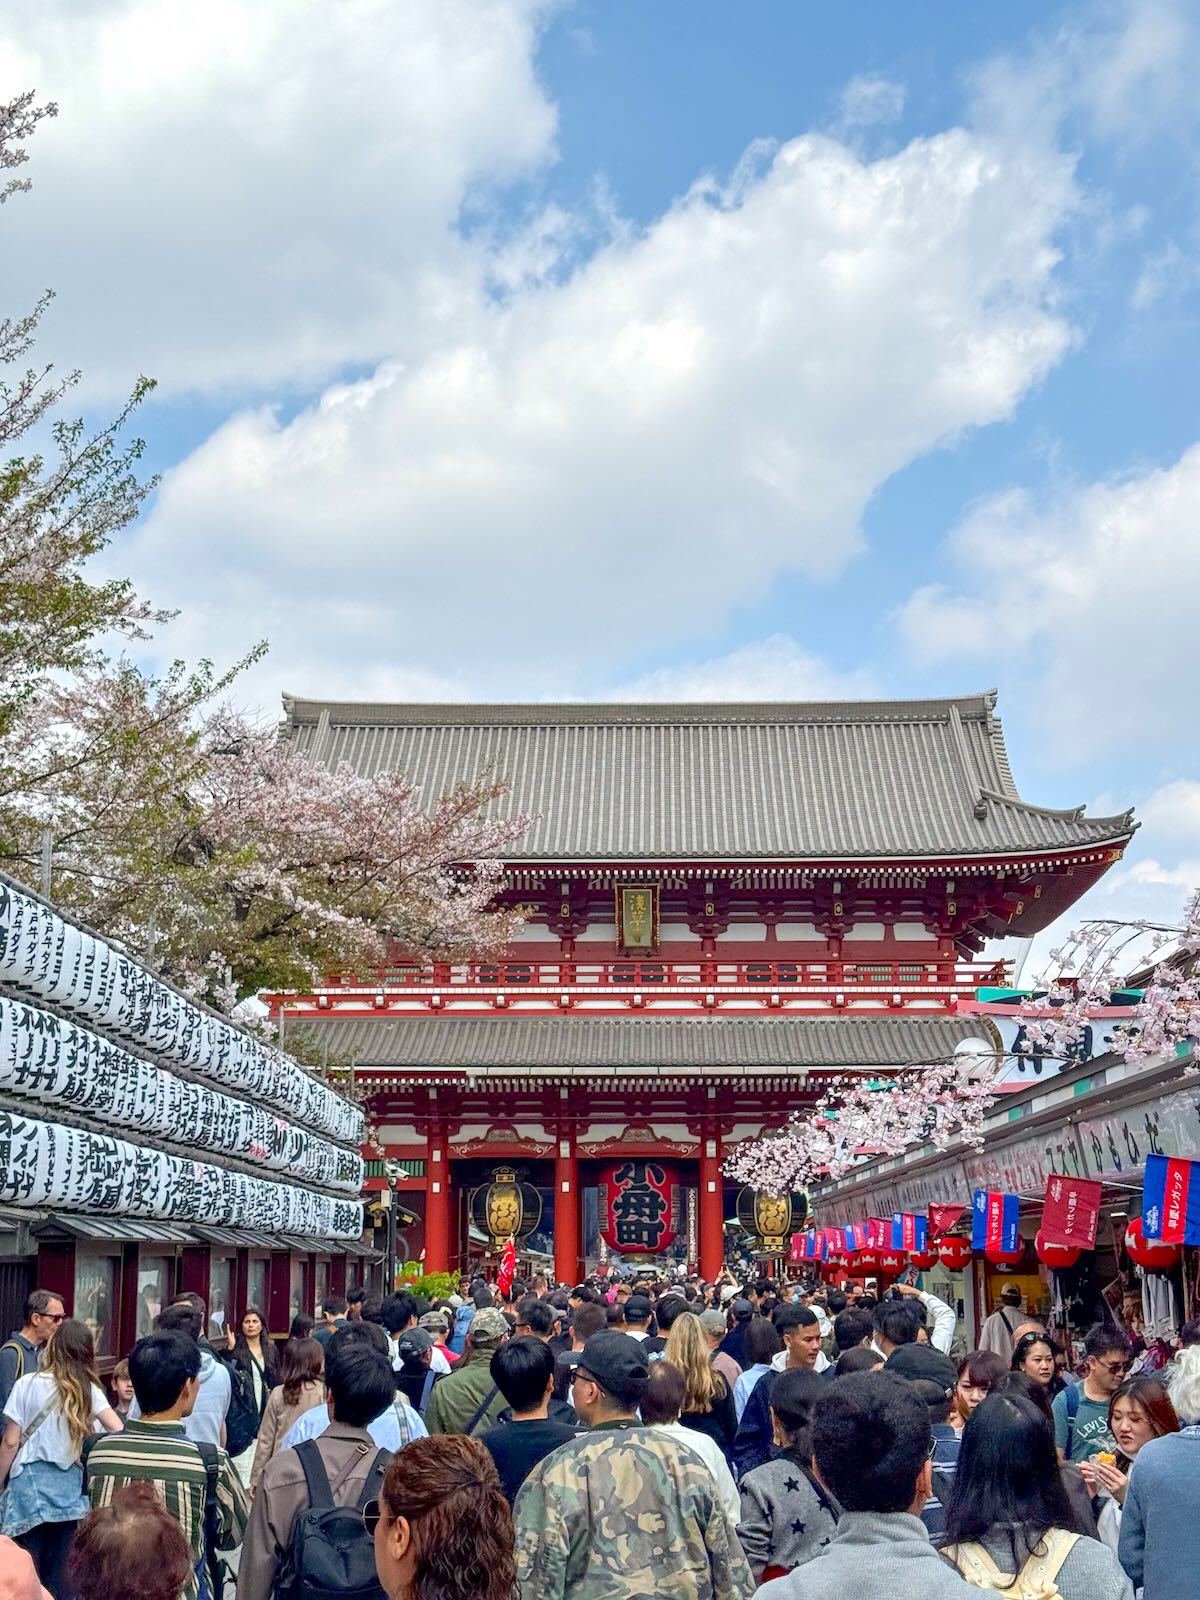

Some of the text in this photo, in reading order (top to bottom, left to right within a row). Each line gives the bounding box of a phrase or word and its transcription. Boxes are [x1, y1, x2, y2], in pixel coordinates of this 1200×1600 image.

[612, 1162, 668, 1249] 小舟町
[1168, 1171, 1183, 1230] 早慶レガッタ
